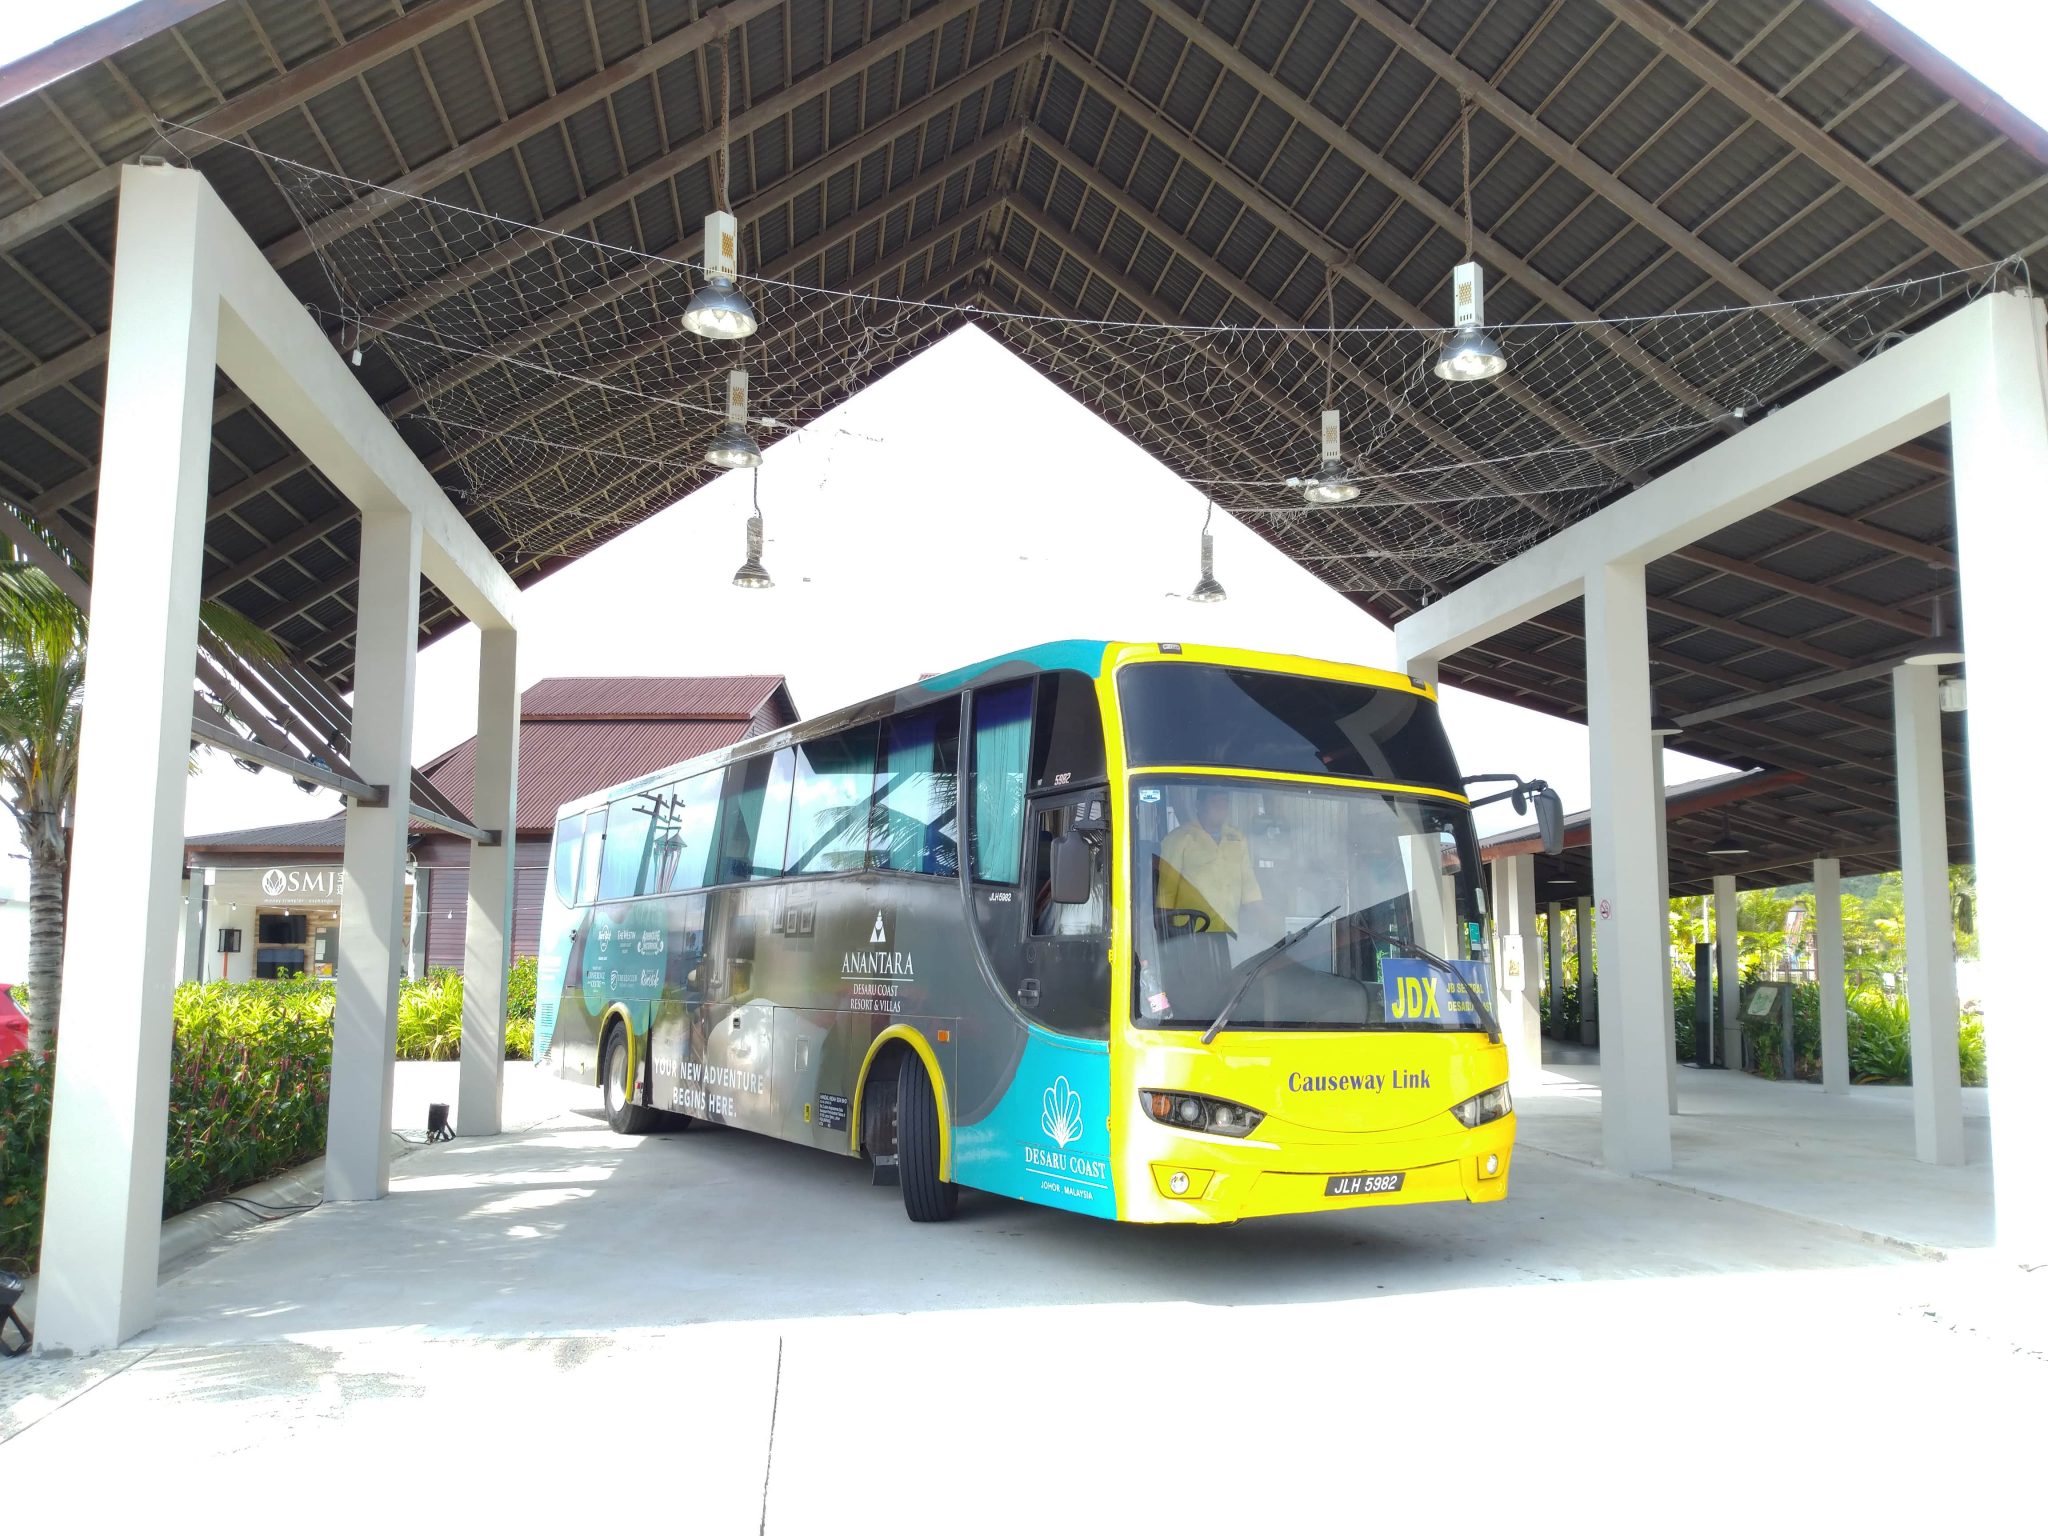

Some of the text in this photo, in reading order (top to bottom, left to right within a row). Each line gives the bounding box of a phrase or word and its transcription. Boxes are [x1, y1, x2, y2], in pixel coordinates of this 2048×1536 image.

[287, 871, 336, 898] SMJ
[841, 951, 914, 975] ANANTARA
[853, 983, 899, 997] DESARU COAST
[1391, 976, 1441, 1019] JDX
[1446, 982, 1455, 994] JB
[850, 998, 901, 1013] RESORT & VILLAS
[654, 1058, 764, 1094] YOUR NEW ADVENTURE
[1288, 1069, 1431, 1094] Causeway Link
[673, 1086, 737, 1117] BEGINS HERE.
[1025, 1146, 1106, 1180] DESARU COAST
[1041, 1181, 1094, 1201] JOHOR MALAYSIA
[1334, 1175, 1398, 1194] JLH 5982
